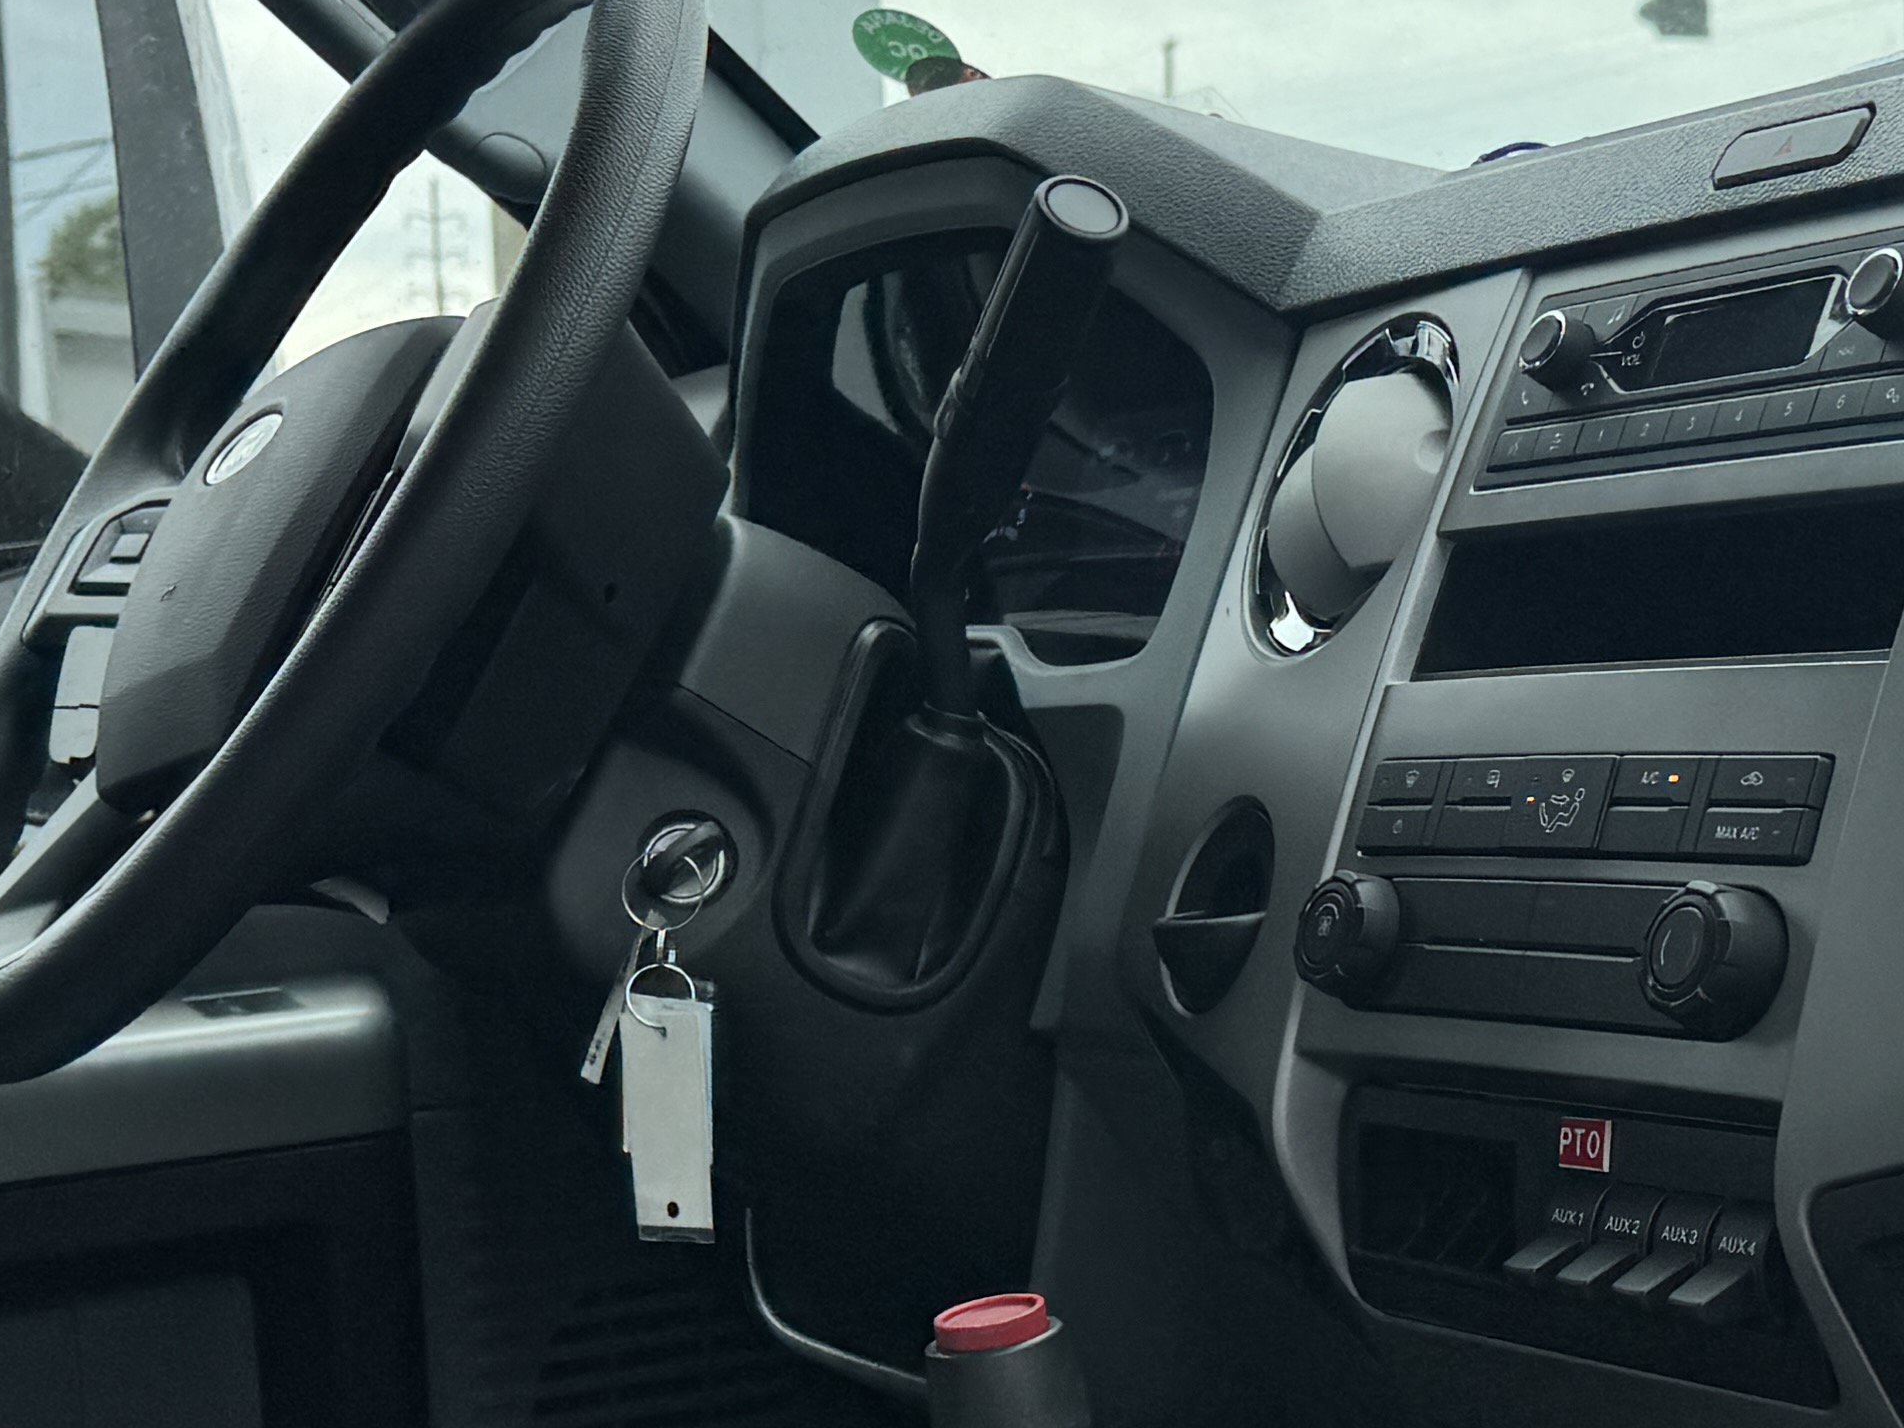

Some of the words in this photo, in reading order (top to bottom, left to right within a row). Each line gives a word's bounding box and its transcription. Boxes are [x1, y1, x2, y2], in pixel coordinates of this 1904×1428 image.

[1783, 401, 1793, 417] 5
[1836, 393, 1846, 410] 6
[1640, 771, 1660, 785] A/C
[1714, 825, 1738, 839] MAX
[1739, 826, 1761, 841] A/C
[1559, 1126, 1601, 1159] PTO
